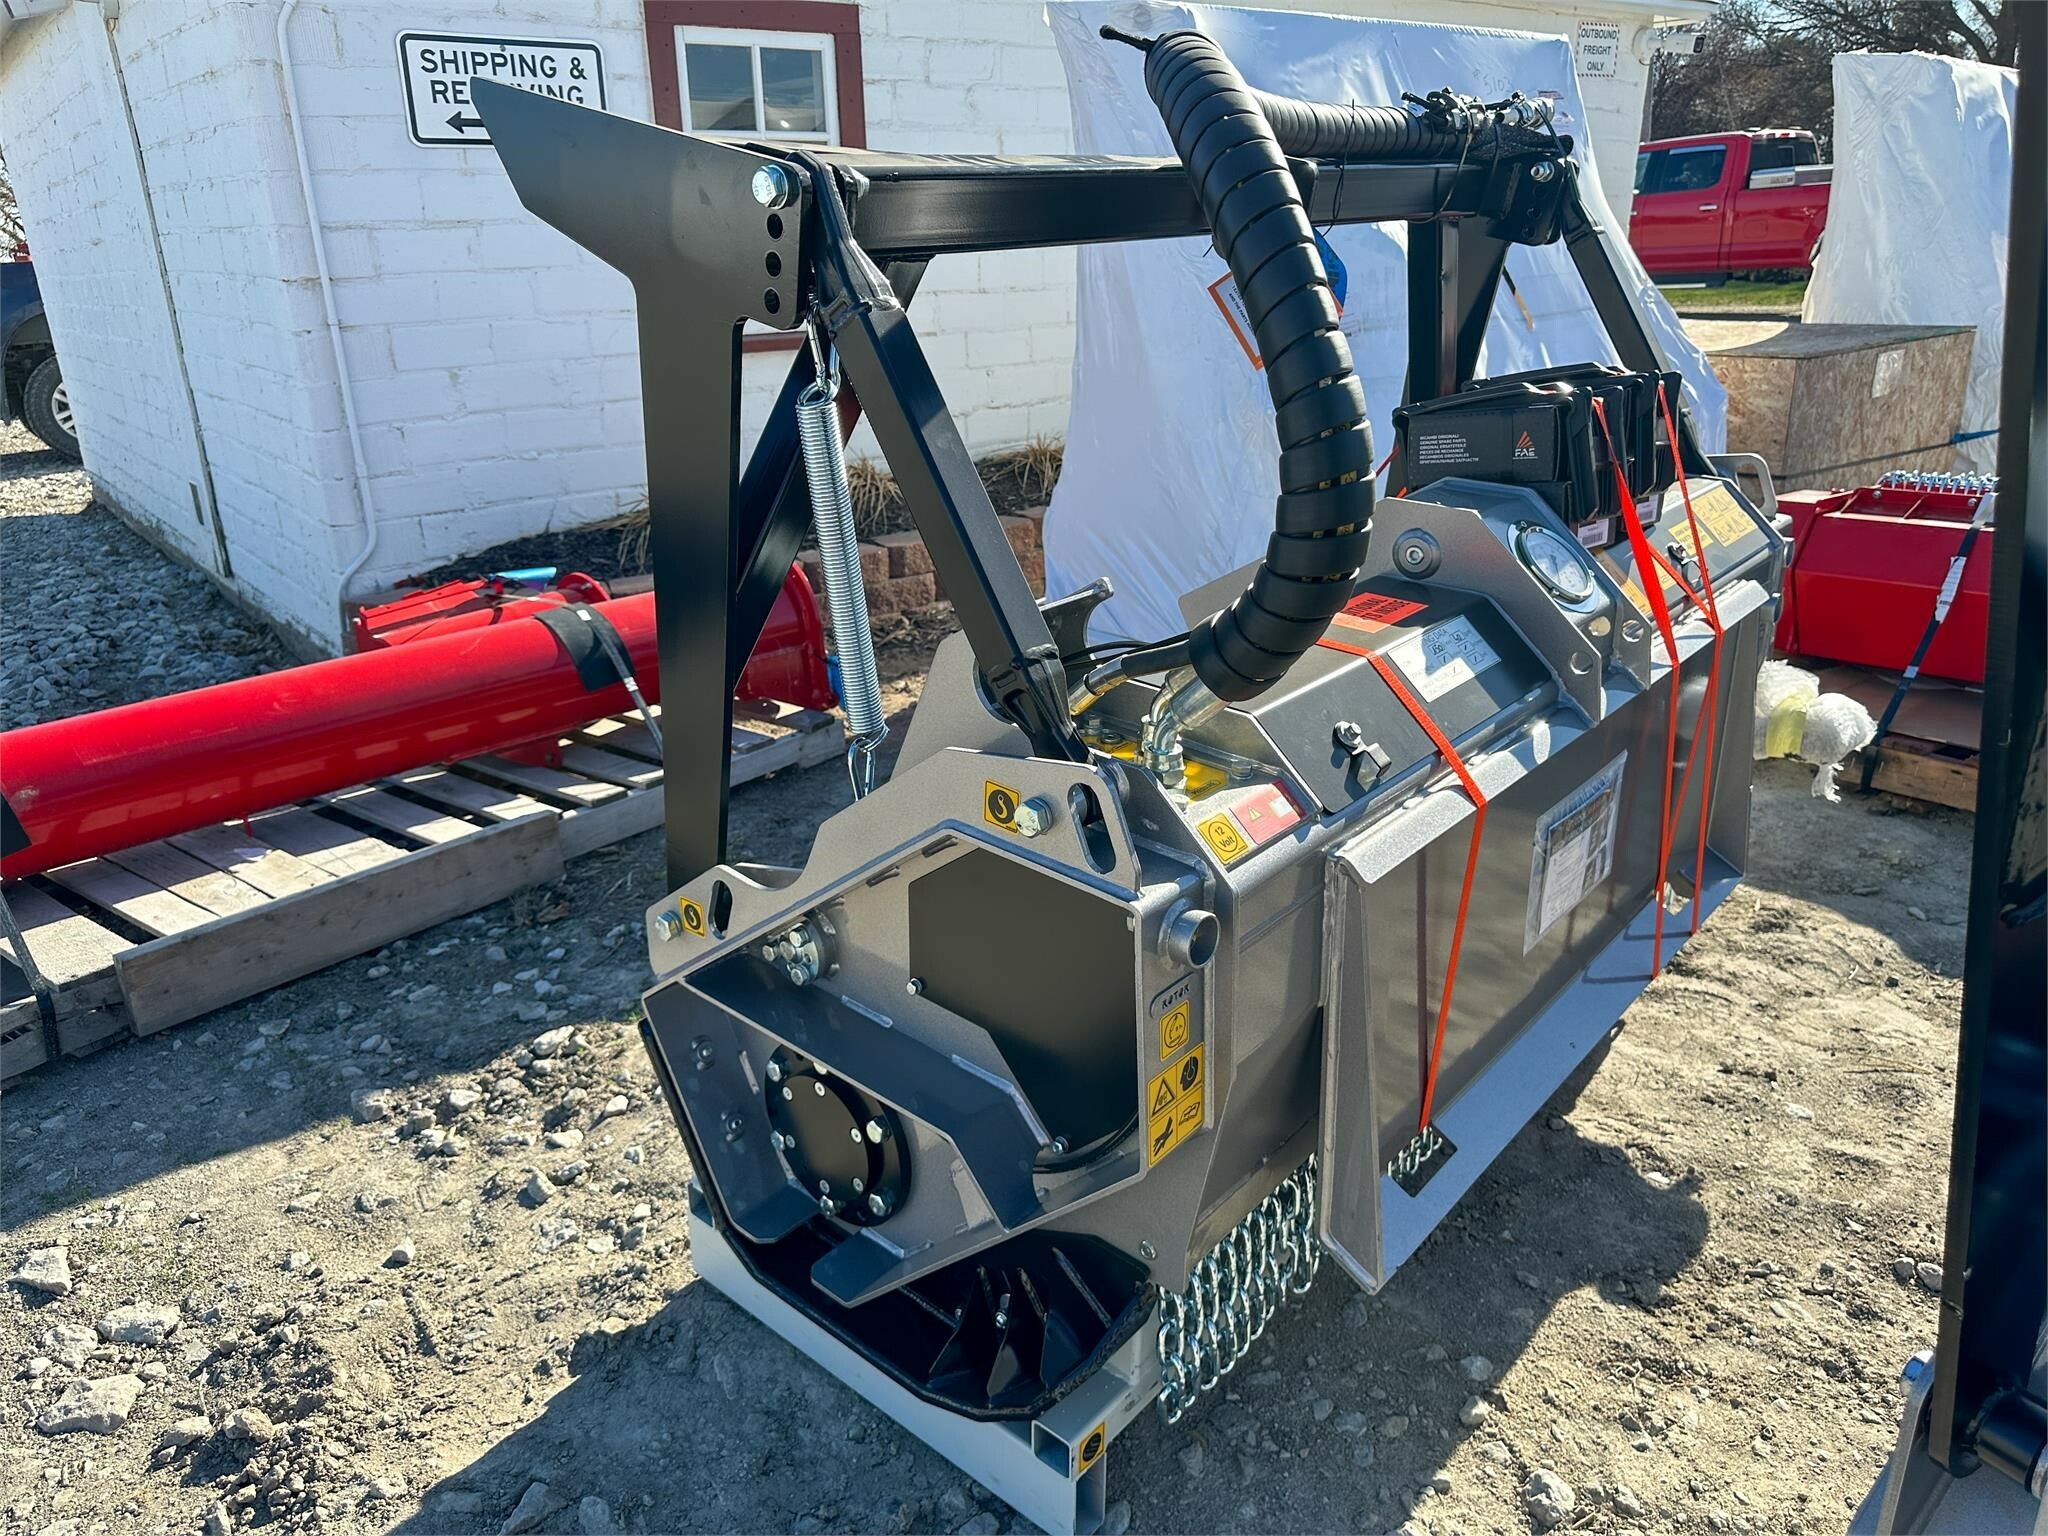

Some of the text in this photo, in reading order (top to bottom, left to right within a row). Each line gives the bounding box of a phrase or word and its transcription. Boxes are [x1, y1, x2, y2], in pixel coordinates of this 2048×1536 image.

[1581, 28, 1617, 39] OUTBOUND
[1583, 45, 1612, 55] FREIGHT
[420, 48, 588, 80] SHIPPING &
[1587, 62, 1604, 71] ONLY
[1515, 447, 1535, 457] FAE
[1214, 825, 1225, 836] 12
[1219, 836, 1235, 848] Volt
